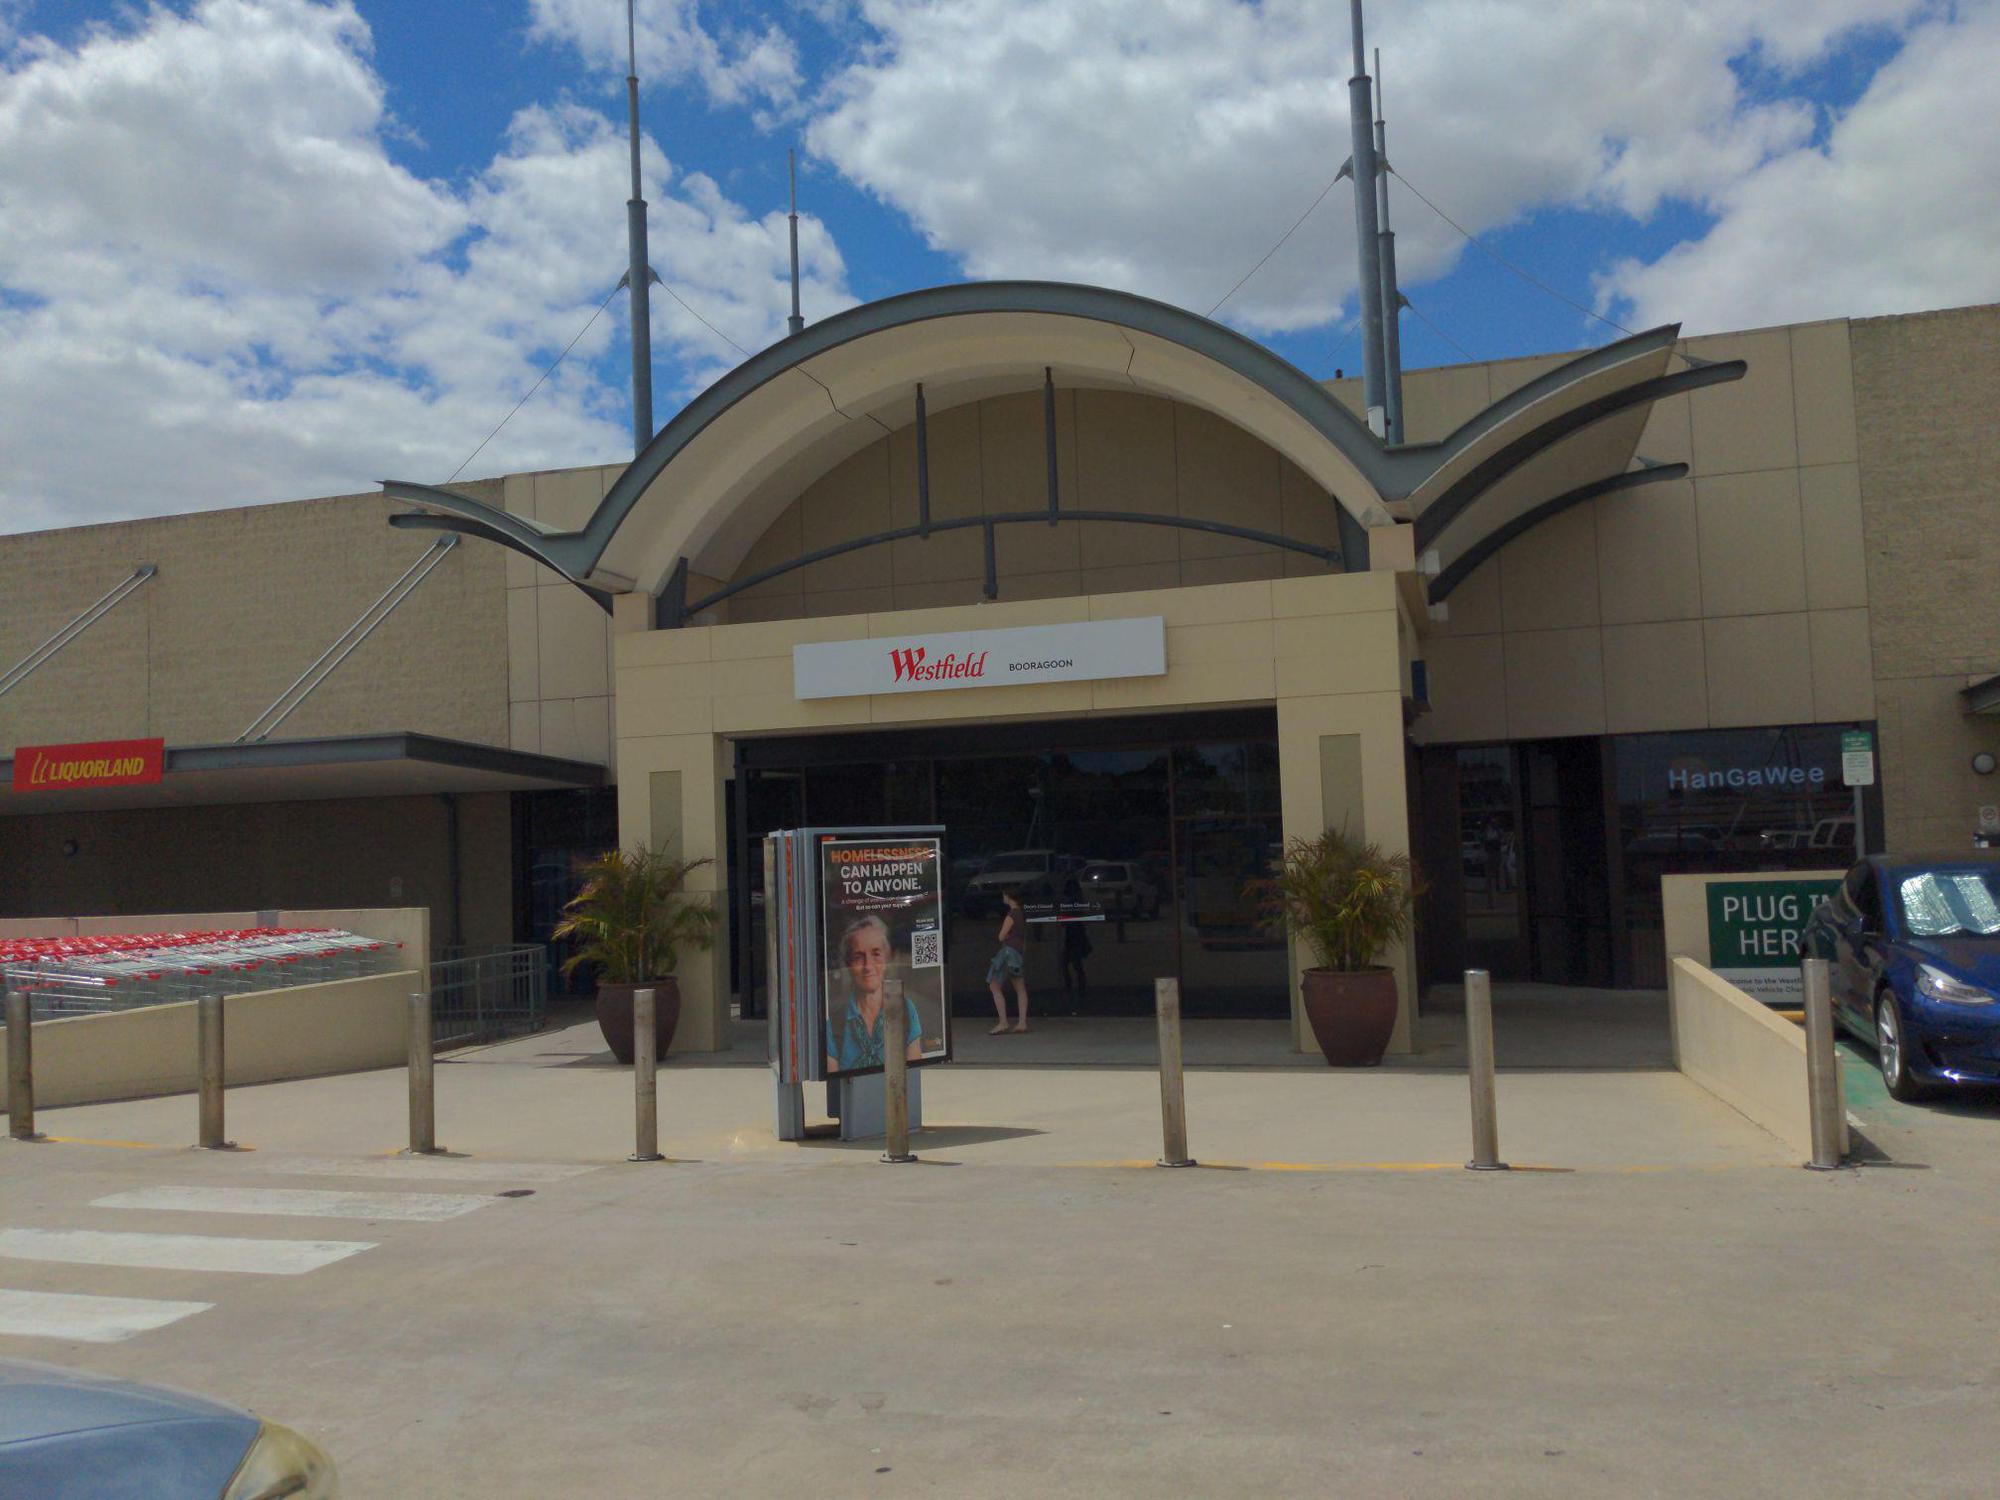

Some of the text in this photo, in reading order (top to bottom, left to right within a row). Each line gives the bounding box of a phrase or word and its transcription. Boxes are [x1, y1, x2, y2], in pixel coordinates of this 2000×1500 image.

[888, 646, 1073, 683] Westfield BOORAGOON
[50, 757, 144, 781] LIQUORLAND
[1668, 766, 1825, 789] HanGaWee
[831, 847, 930, 863] HOMELESSNESS
[841, 863, 923, 879] CAN HAPPEN
[843, 878, 921, 894] TO ANYONE.
[1723, 895, 1799, 922] PLUG
[1740, 929, 1806, 955] HER
